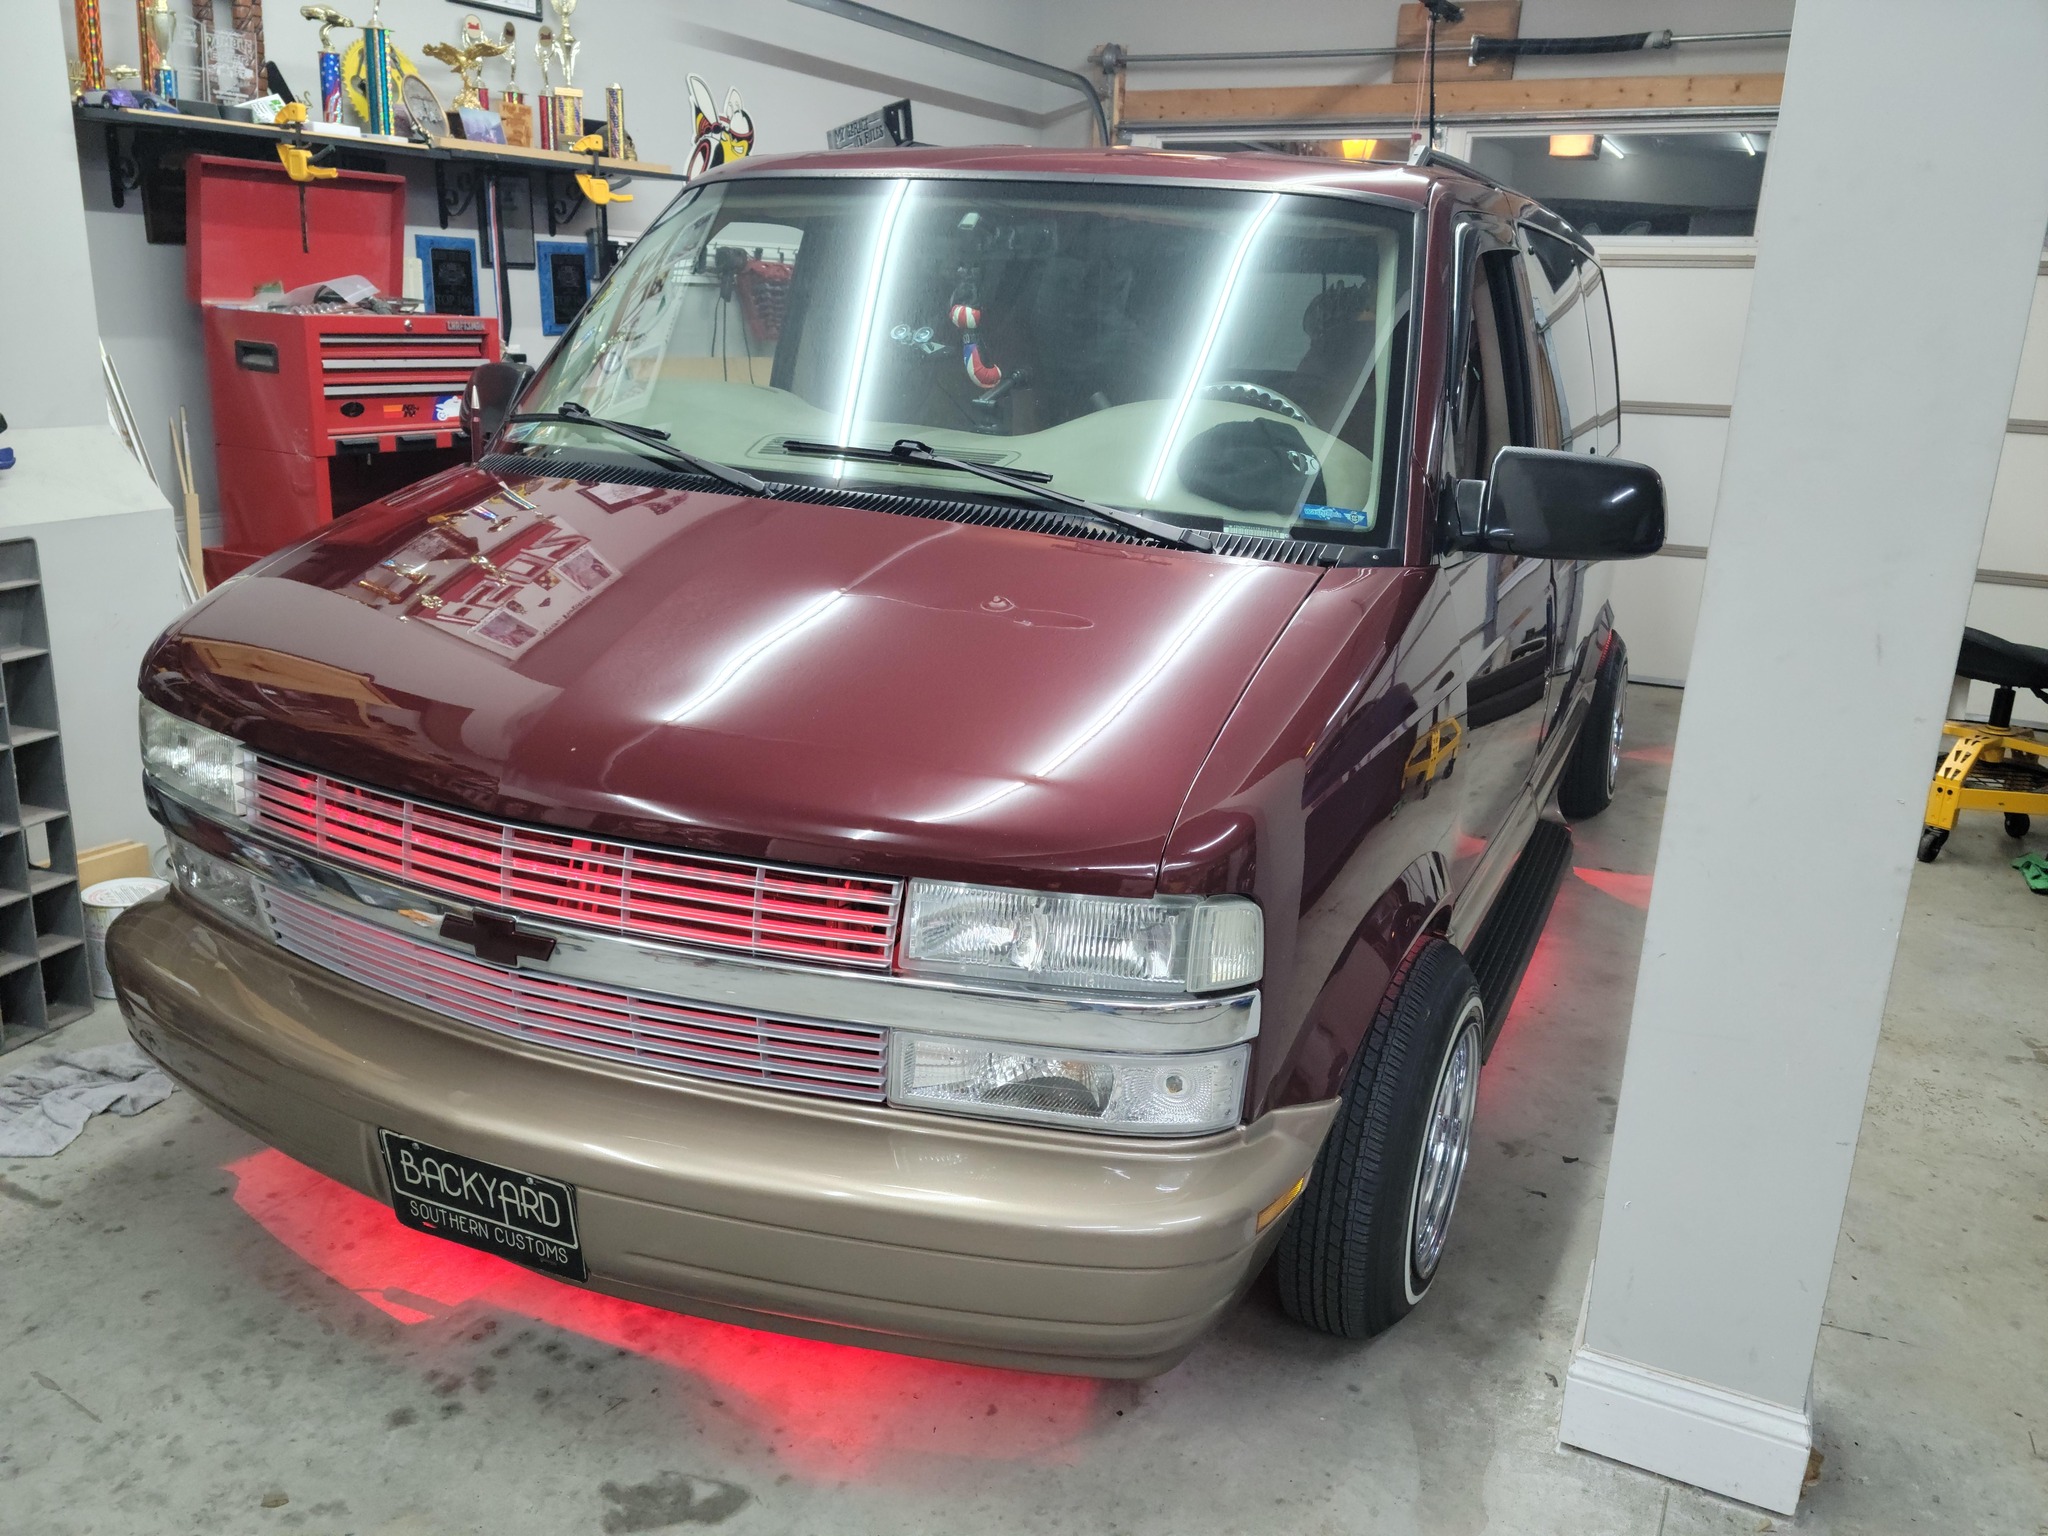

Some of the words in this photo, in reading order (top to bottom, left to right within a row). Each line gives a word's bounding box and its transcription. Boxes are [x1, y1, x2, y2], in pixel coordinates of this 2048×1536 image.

[834, 127, 847, 143] MY
[400, 1149, 561, 1228] BACKYARD
[410, 1201, 490, 1240] SOUTHERN
[494, 1227, 569, 1264] CUSTOMS
